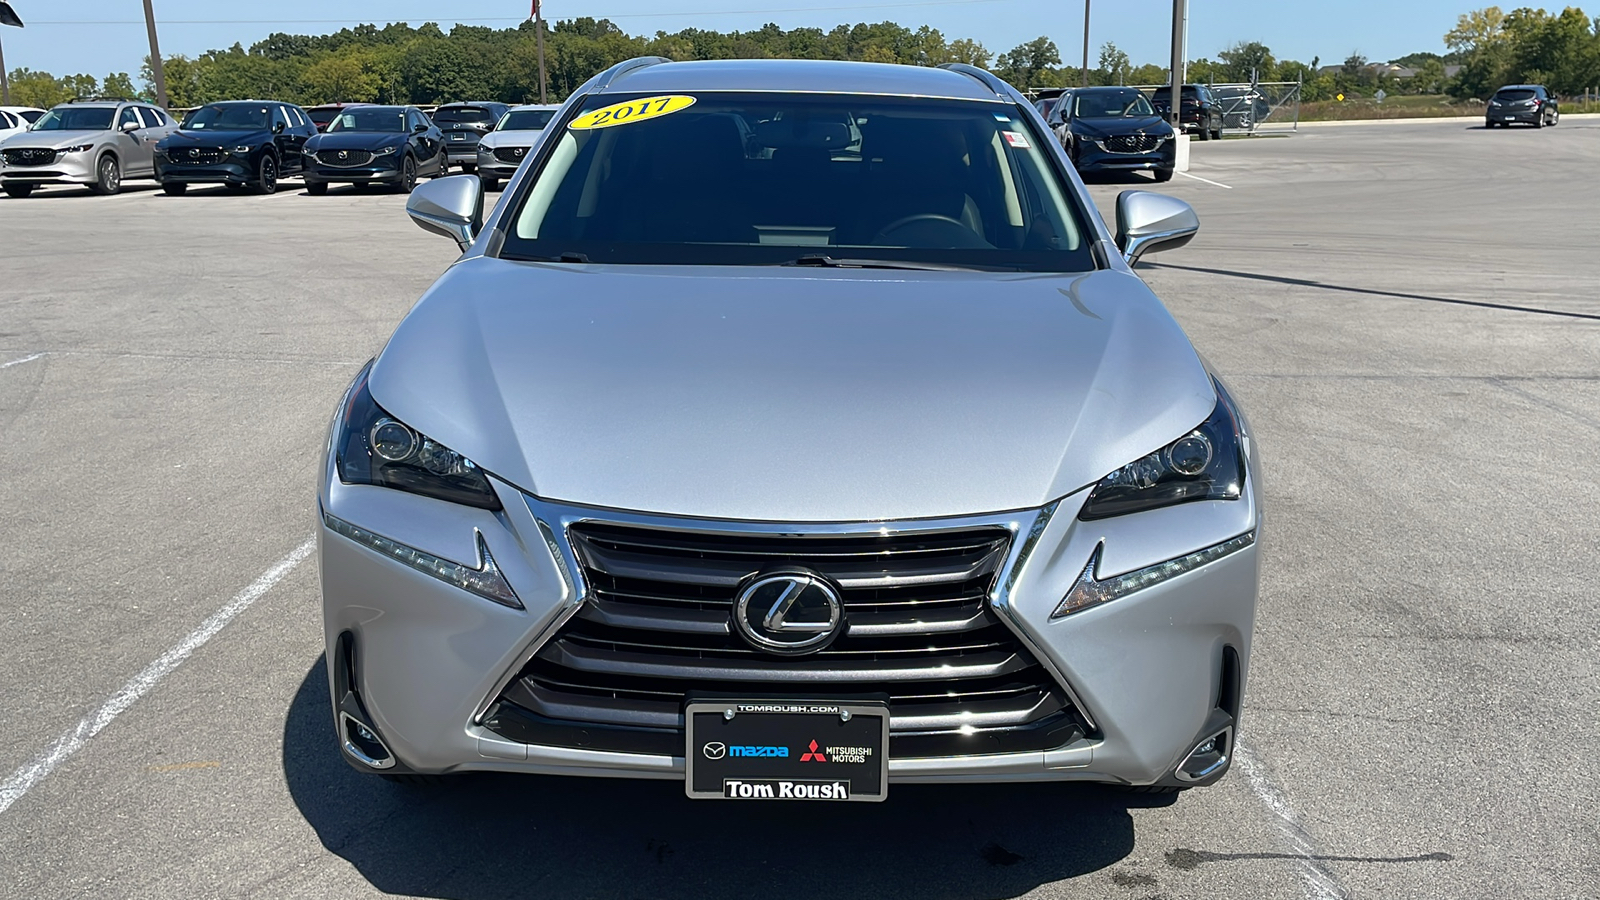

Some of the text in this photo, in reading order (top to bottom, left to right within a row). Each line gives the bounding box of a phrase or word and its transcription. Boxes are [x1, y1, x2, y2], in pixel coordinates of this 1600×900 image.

[591, 98, 671, 126] 2017
[738, 705, 838, 713] TOMROUSH.COM
[729, 745, 789, 757] mazda
[826, 747, 872, 756] MITSUBISHI
[832, 755, 865, 763] MOTORS
[726, 781, 847, 799] Tom Roush
